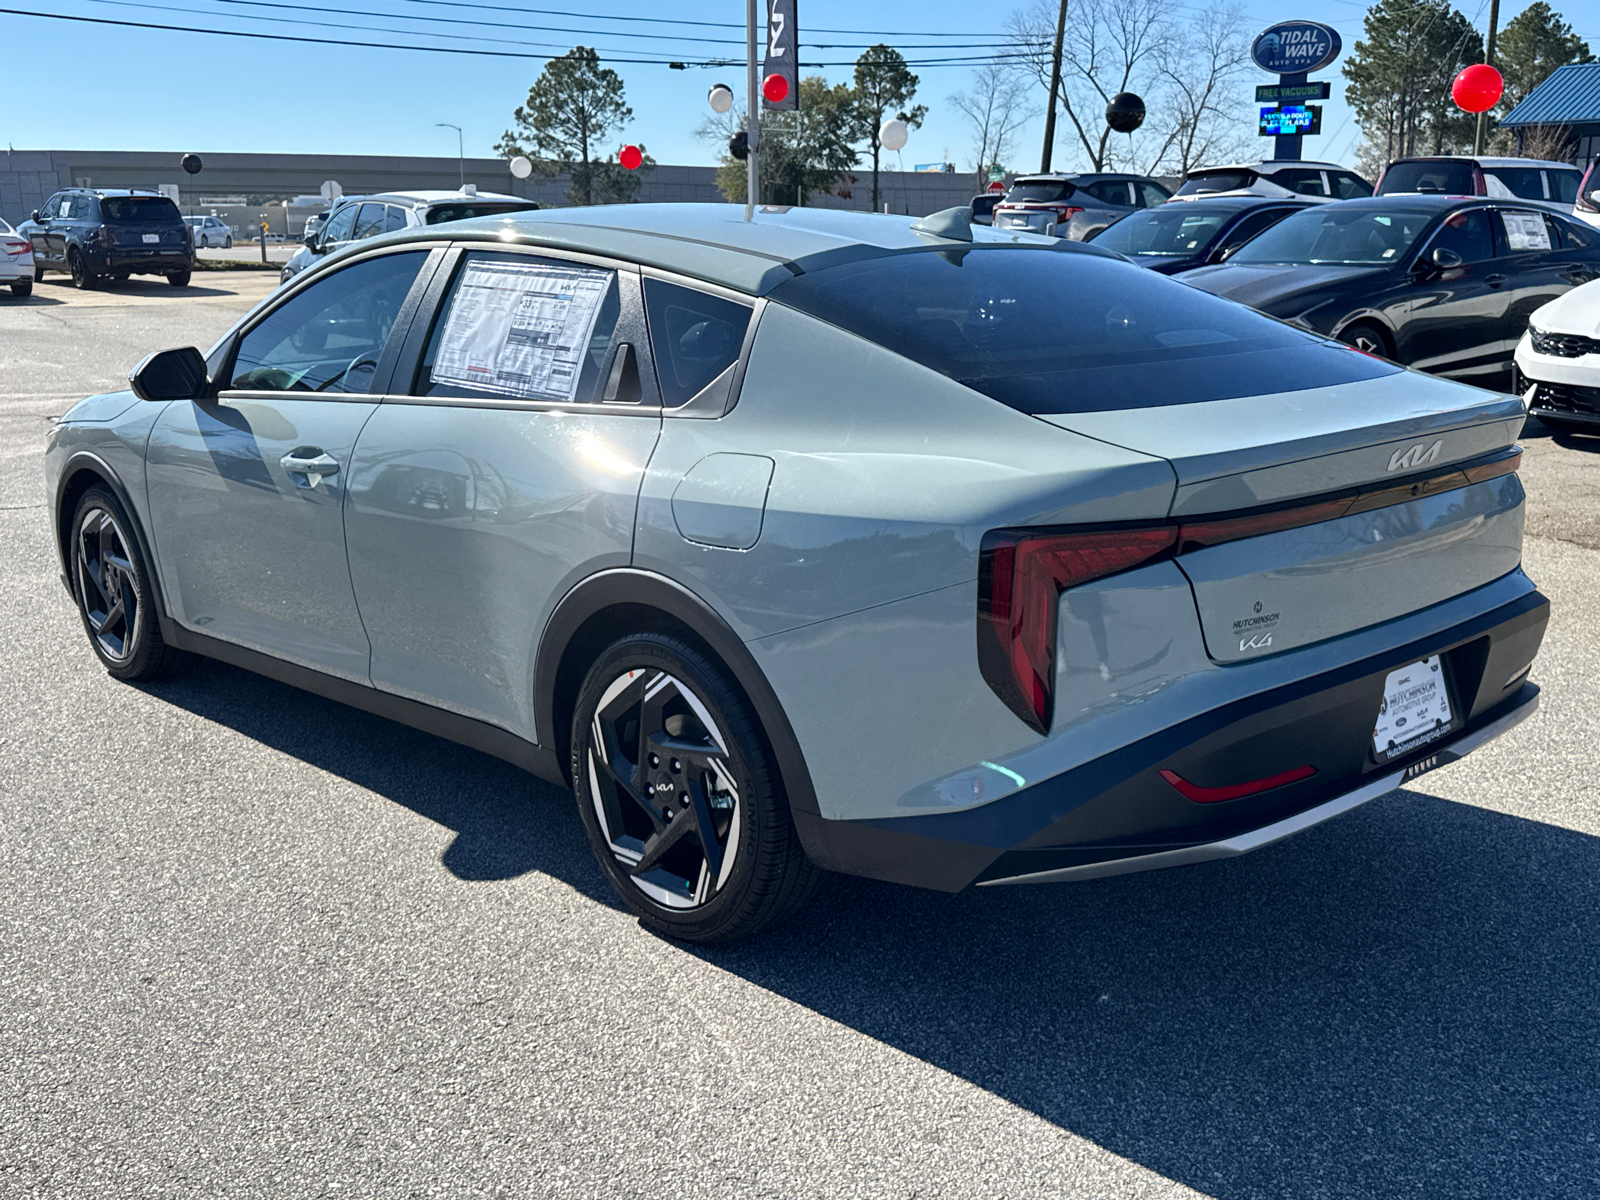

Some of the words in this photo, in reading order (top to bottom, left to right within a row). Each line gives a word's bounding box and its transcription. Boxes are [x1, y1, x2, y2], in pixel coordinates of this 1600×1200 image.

[1280, 29, 1318, 44] TIDAL
[1285, 43, 1325, 58] WAVE
[1258, 88, 1279, 98] FREE
[1280, 86, 1319, 96] VACUUMS
[522, 299, 533, 308] 33
[1386, 439, 1442, 472] KIA
[1232, 612, 1280, 629] HUTCHINSON
[1239, 632, 1272, 651] K4
[1389, 680, 1436, 708] HUTCHINSON
[1392, 699, 1421, 715] AUTOMOTIVE
[1421, 691, 1436, 704] GROUP
[1386, 724, 1450, 759] Hutchinsonautogroup.com
[656, 783, 674, 791] KIA
[744, 779, 757, 856] KUMHO
